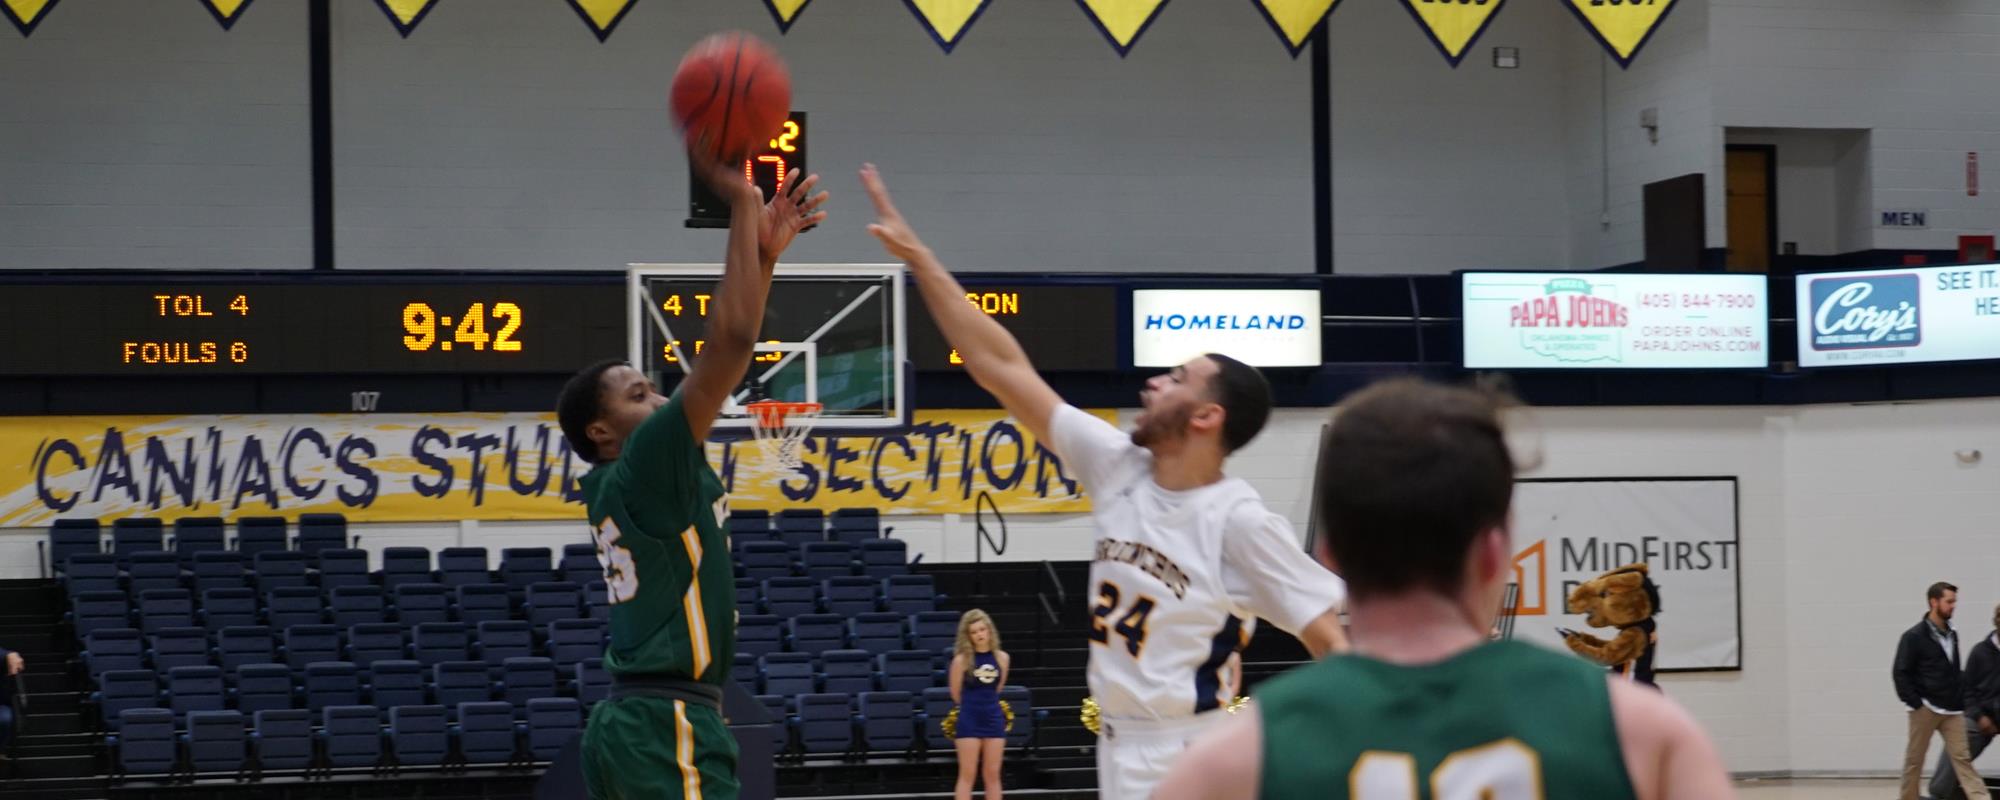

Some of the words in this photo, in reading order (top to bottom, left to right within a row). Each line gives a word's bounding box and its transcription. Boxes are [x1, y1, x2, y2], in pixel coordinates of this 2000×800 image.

[1882, 211, 1925, 227] MEN
[1936, 271, 1973, 291] SEE
[154, 295, 213, 316] TOL
[229, 295, 249, 316] 4
[663, 295, 682, 316] 4
[1636, 293, 1676, 308] (405)
[1681, 294, 1756, 308] 844-7900
[1510, 295, 1561, 328] PAPA
[1814, 281, 1918, 343] Cory's
[403, 302, 522, 352] 9:42
[1145, 314, 1305, 331] HOMELAND
[1641, 326, 1693, 338] ORDER
[1698, 326, 1753, 338] ONLINE
[124, 342, 217, 364] FOULS
[230, 342, 248, 363] 6
[1632, 340, 1762, 352] PAPAJOHNS.COM
[352, 391, 381, 411] 107
[33, 425, 379, 513] CANIACS
[1087, 579, 1157, 660] 24
